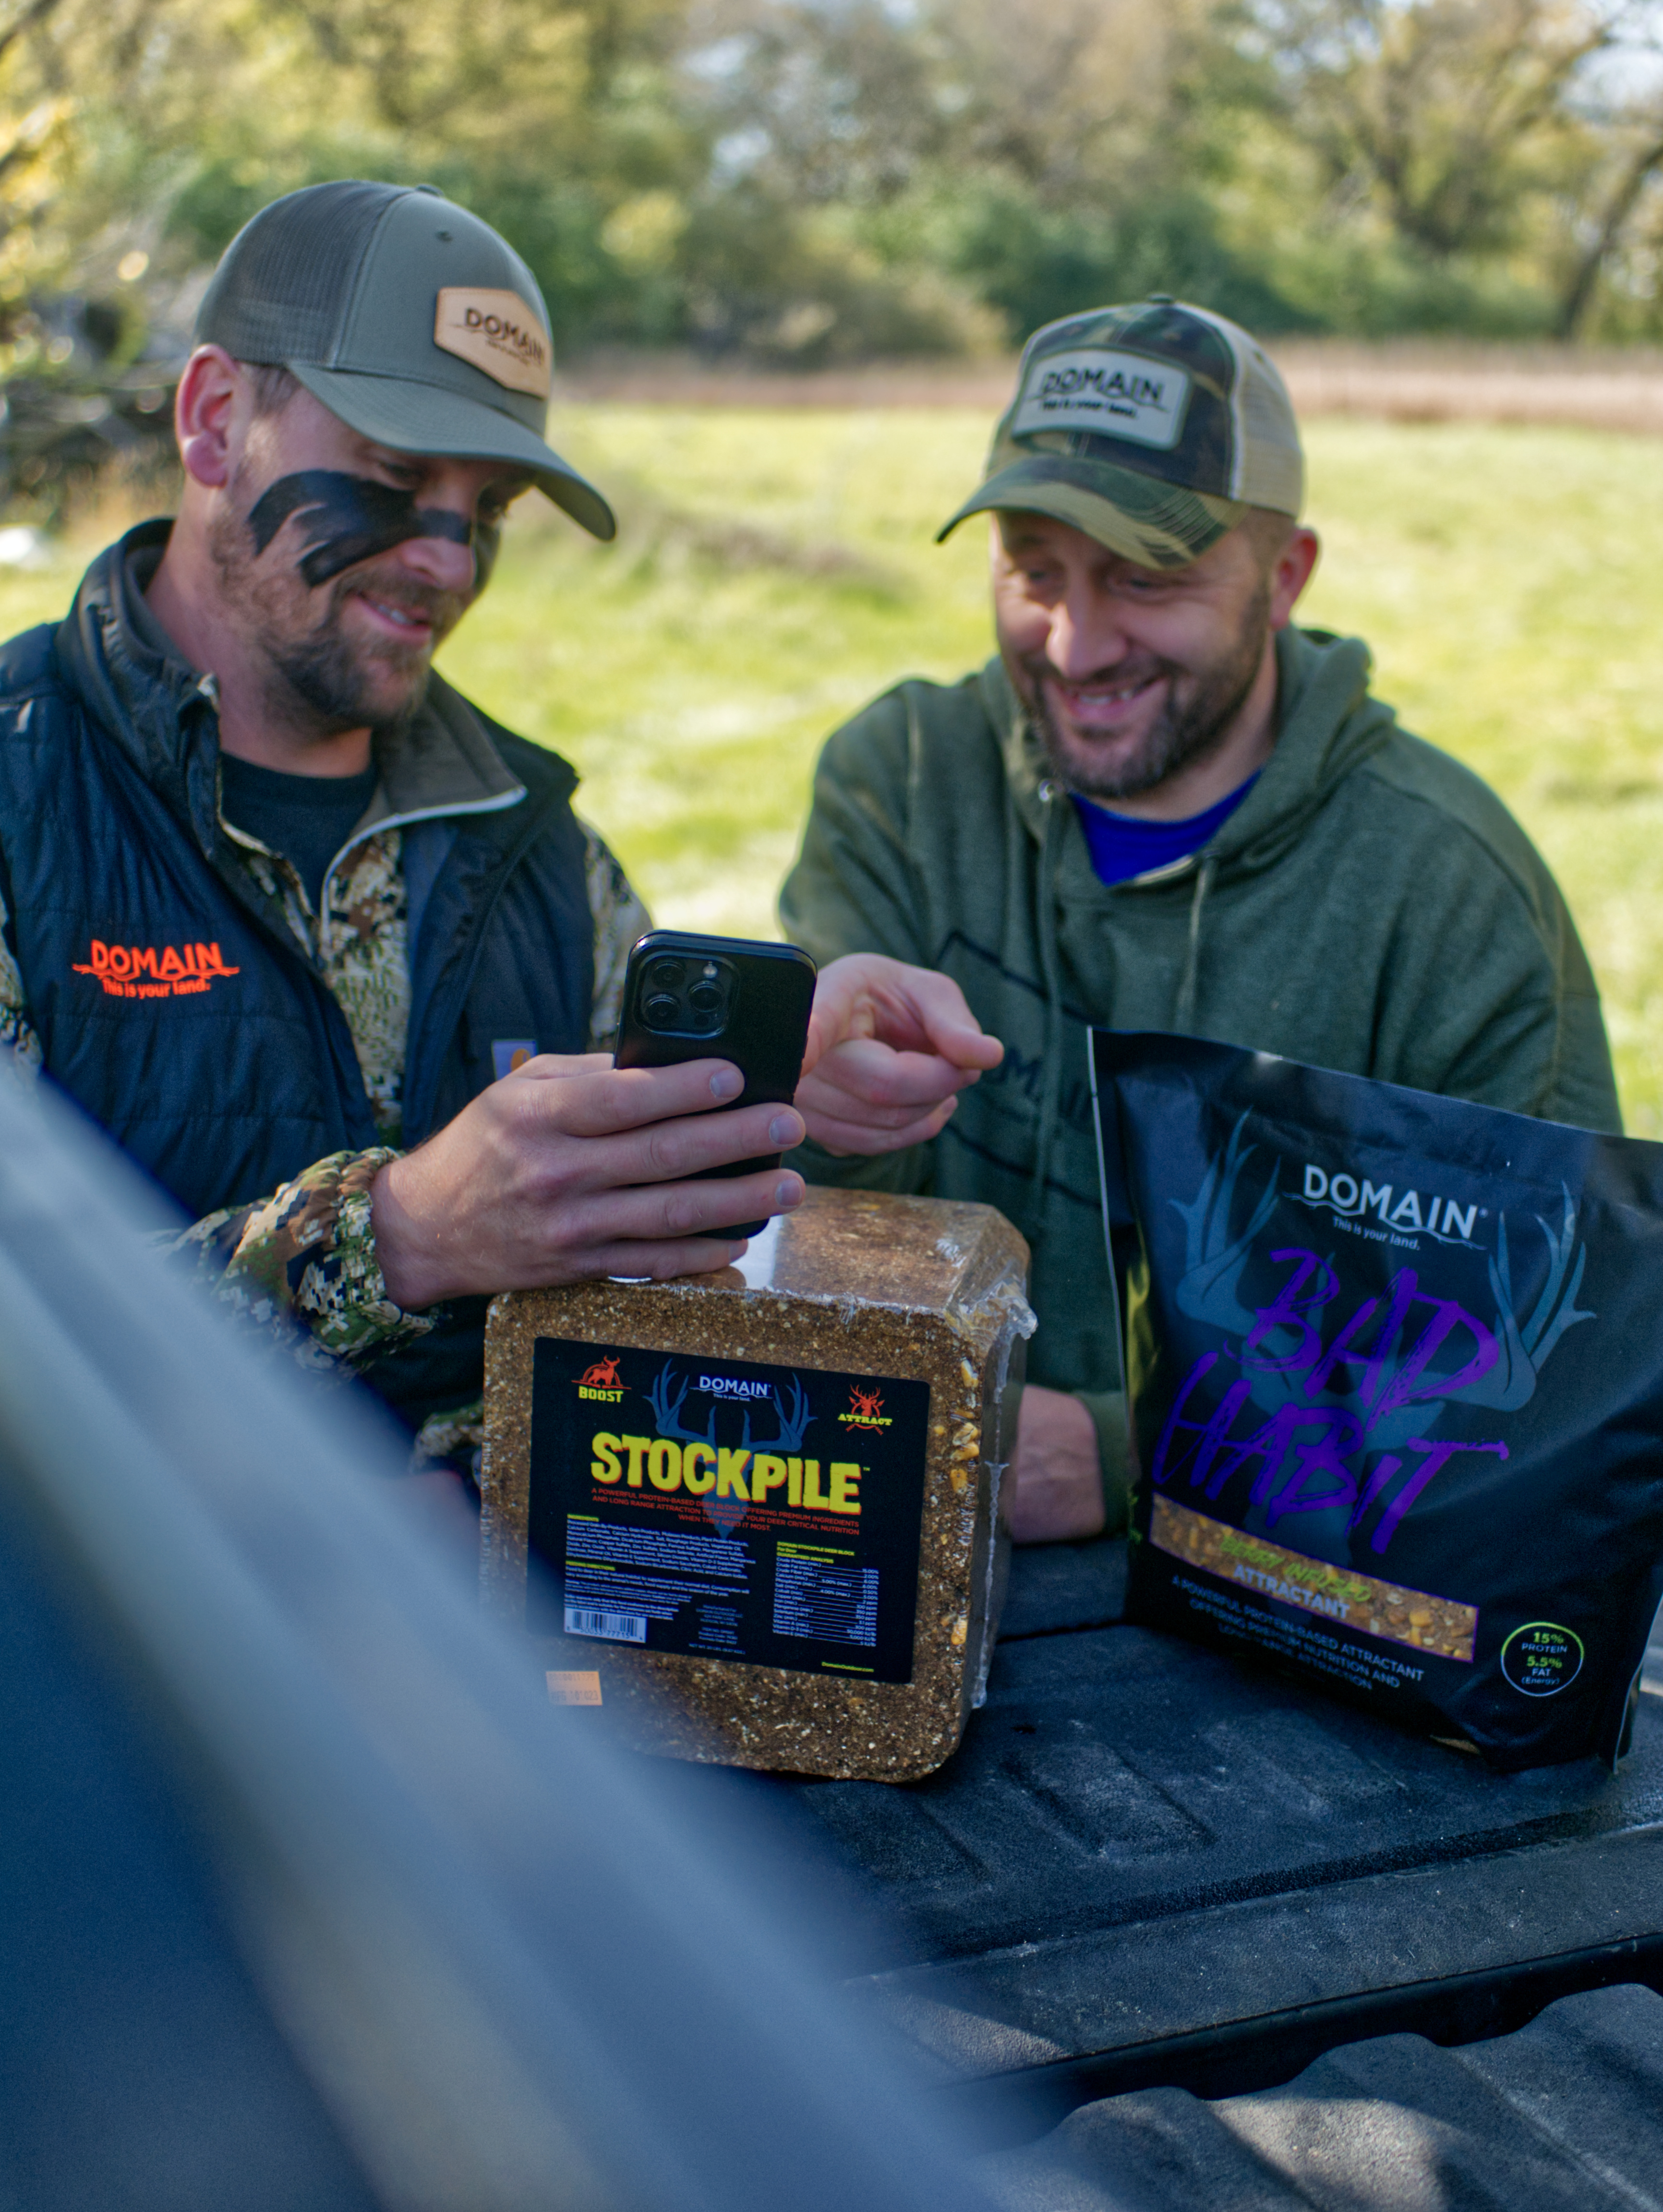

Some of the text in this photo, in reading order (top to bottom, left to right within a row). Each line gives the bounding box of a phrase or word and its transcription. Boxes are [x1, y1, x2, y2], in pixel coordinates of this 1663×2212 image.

[466, 307, 545, 366] DOMAIN
[1042, 368, 1164, 402] DOMAIN
[91, 939, 223, 978] DOMAIN
[102, 977, 123, 996] This
[124, 982, 136, 998] is
[137, 984, 170, 999] your
[1303, 1164, 1478, 1239] DOMAIN
[1332, 1215, 1421, 1250] This is your land.
[1223, 1247, 1500, 1432] BAD
[578, 1385, 624, 1403] BOOST
[699, 1375, 768, 1396] DOMAIN
[837, 1413, 892, 1426] ATTRACT
[1152, 1351, 1509, 1555] HABIT
[590, 1431, 862, 1515] STOCKPILE
[598, 1488, 638, 1499] POWERFUL
[639, 1493, 695, 1506] PROTEIN-BASED
[696, 1500, 715, 1509] DEER
[716, 1502, 740, 1511] BLOCK
[741, 1505, 777, 1516] OFFERING
[778, 1511, 811, 1521] PREMIUM
[812, 1516, 859, 1527] INGREDIENTS
[630, 1500, 655, 1509] RANGE
[656, 1503, 700, 1515] ATTRACTION
[745, 1515, 765, 1523] YOUR
[767, 1517, 786, 1526] DEER
[787, 1520, 819, 1530] CRITICAL
[820, 1525, 859, 1535] NUTRITION
[678, 1514, 700, 1523] WHEN
[1233, 1564, 1350, 1619] ATTRACTANT
[1521, 1642, 1567, 1653] PROTEIN
[1533, 1631, 1564, 1644] 15%
[1340, 1643, 1425, 1681] ATTRACTANT
[1372, 1670, 1400, 1688] AND
[1526, 1655, 1562, 1669] 5.5%
[1532, 1667, 1551, 1676] FAT
